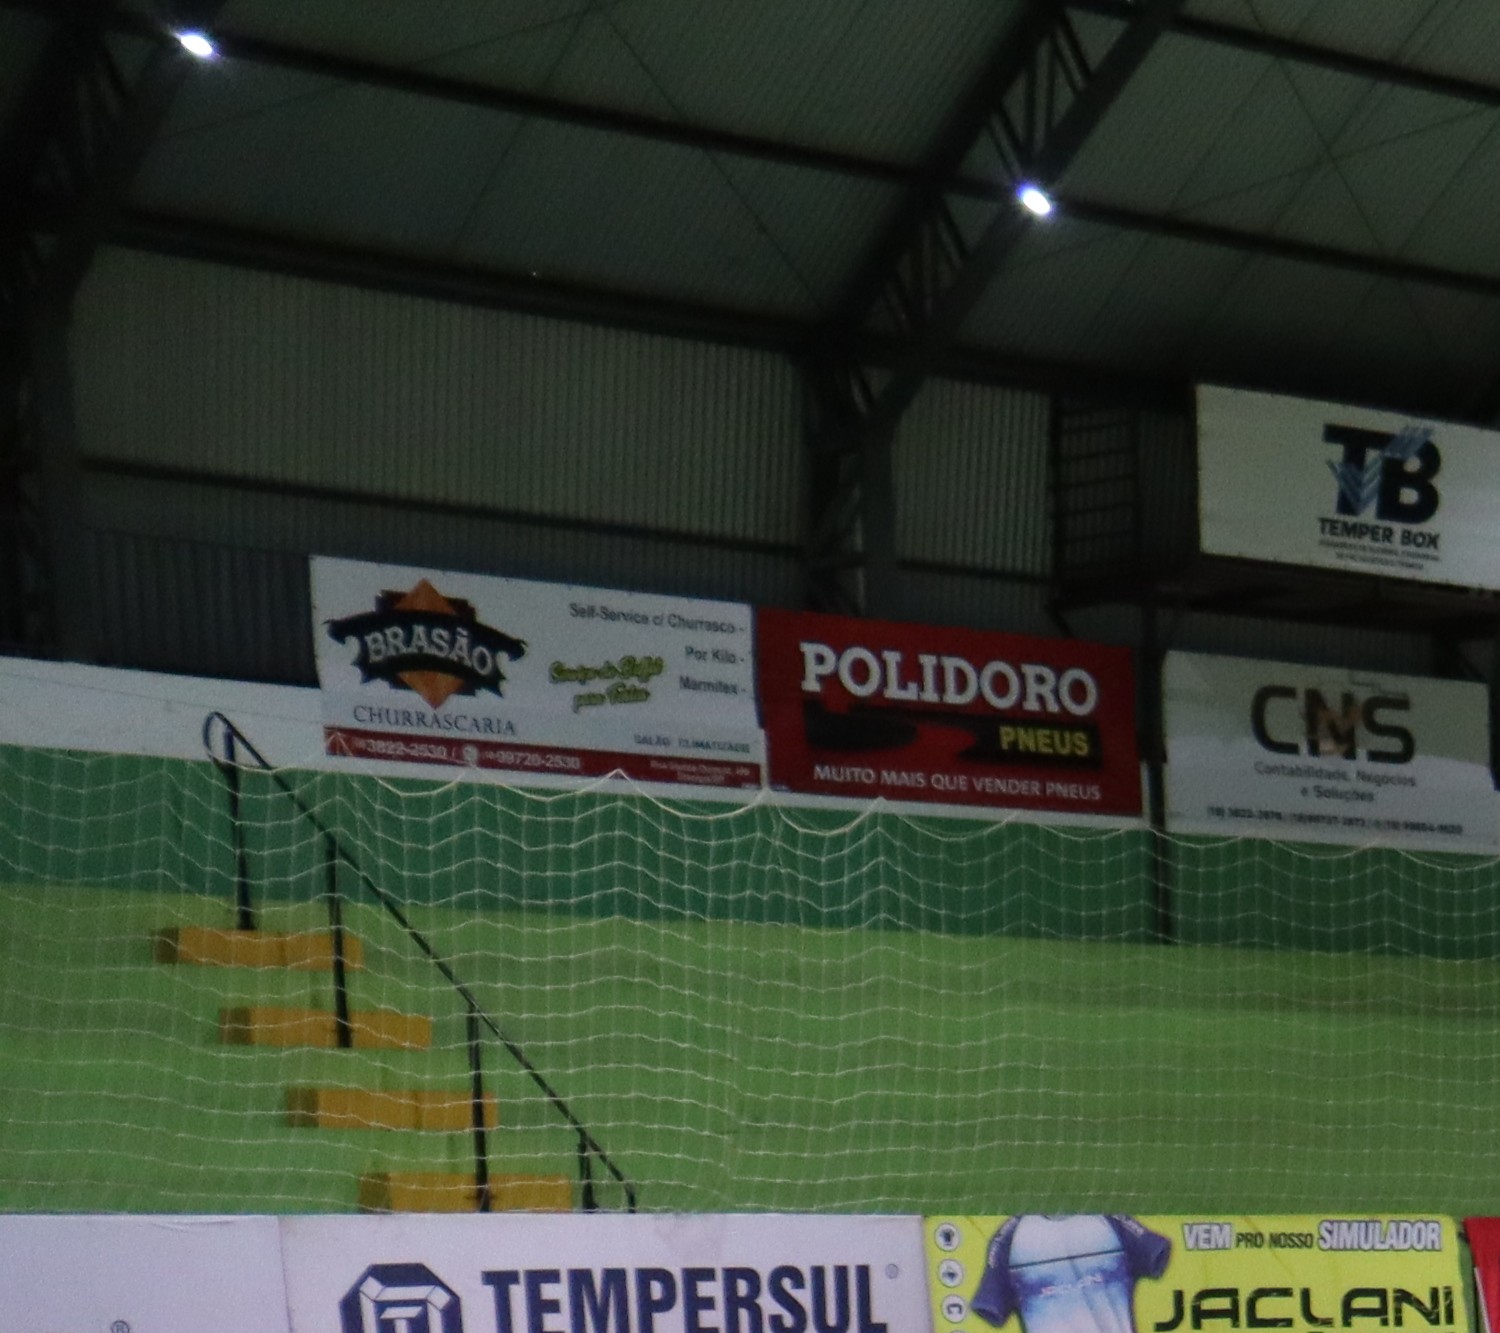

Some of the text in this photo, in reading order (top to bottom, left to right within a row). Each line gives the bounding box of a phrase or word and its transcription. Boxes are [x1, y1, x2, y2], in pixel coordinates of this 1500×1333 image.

[1318, 518, 1440, 549] TEMPER BOX
[569, 602, 649, 625] Self-Service
[667, 613, 735, 633] Churrasco
[365, 625, 493, 676] BRASÃO
[685, 646, 736, 664] Por Kilo
[800, 641, 1098, 716] POLIDORO
[353, 705, 516, 735] CHURRASCARIA
[1251, 685, 1416, 764] CNS
[1000, 725, 1089, 756] PNEUS
[813, 764, 1101, 800] MUITO MAIS QUE VENDER PNEUS
[1183, 1220, 1442, 1251] VEM PRO NOSSO SIMULADOR
[1154, 1286, 1455, 1332] JACLANI
